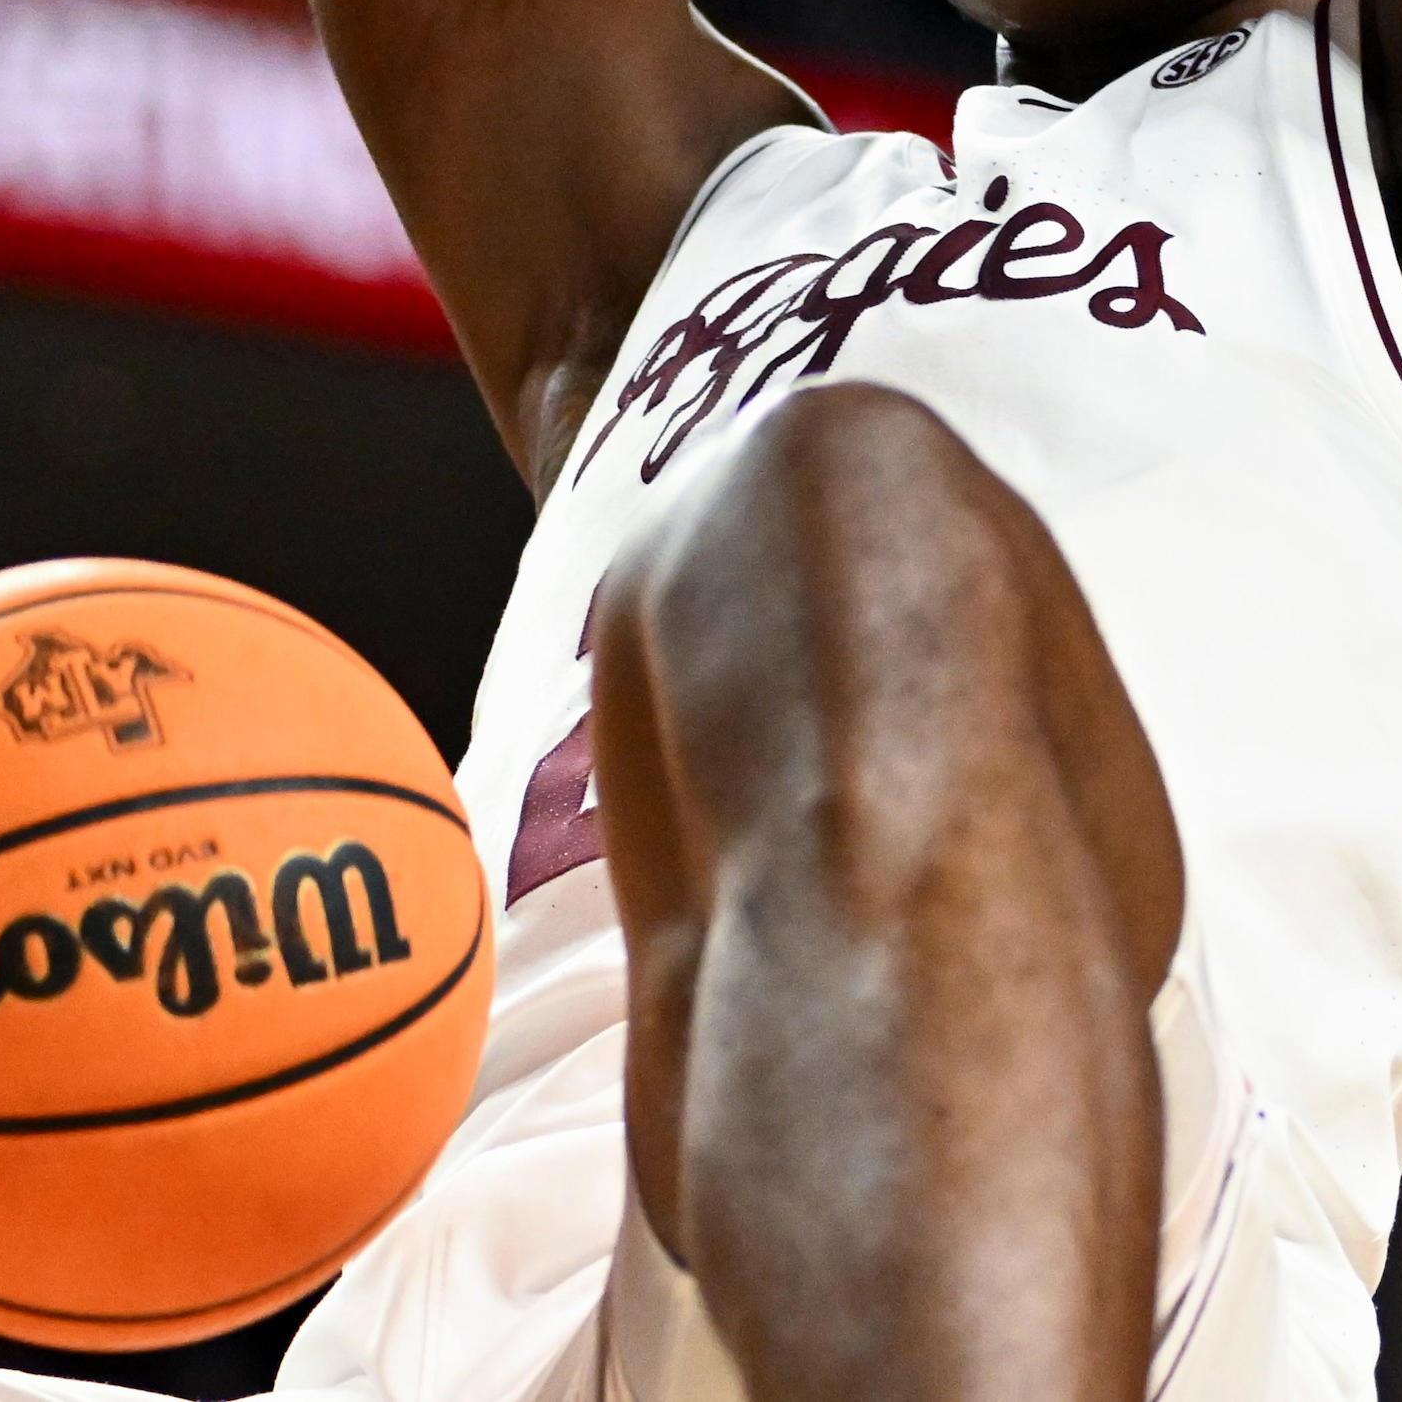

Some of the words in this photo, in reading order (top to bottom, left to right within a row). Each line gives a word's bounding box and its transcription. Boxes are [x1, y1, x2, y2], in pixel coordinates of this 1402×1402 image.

[1162, 33, 1243, 83] SEC
[149, 839, 219, 871] EVO
[66, 858, 136, 892] NXT
